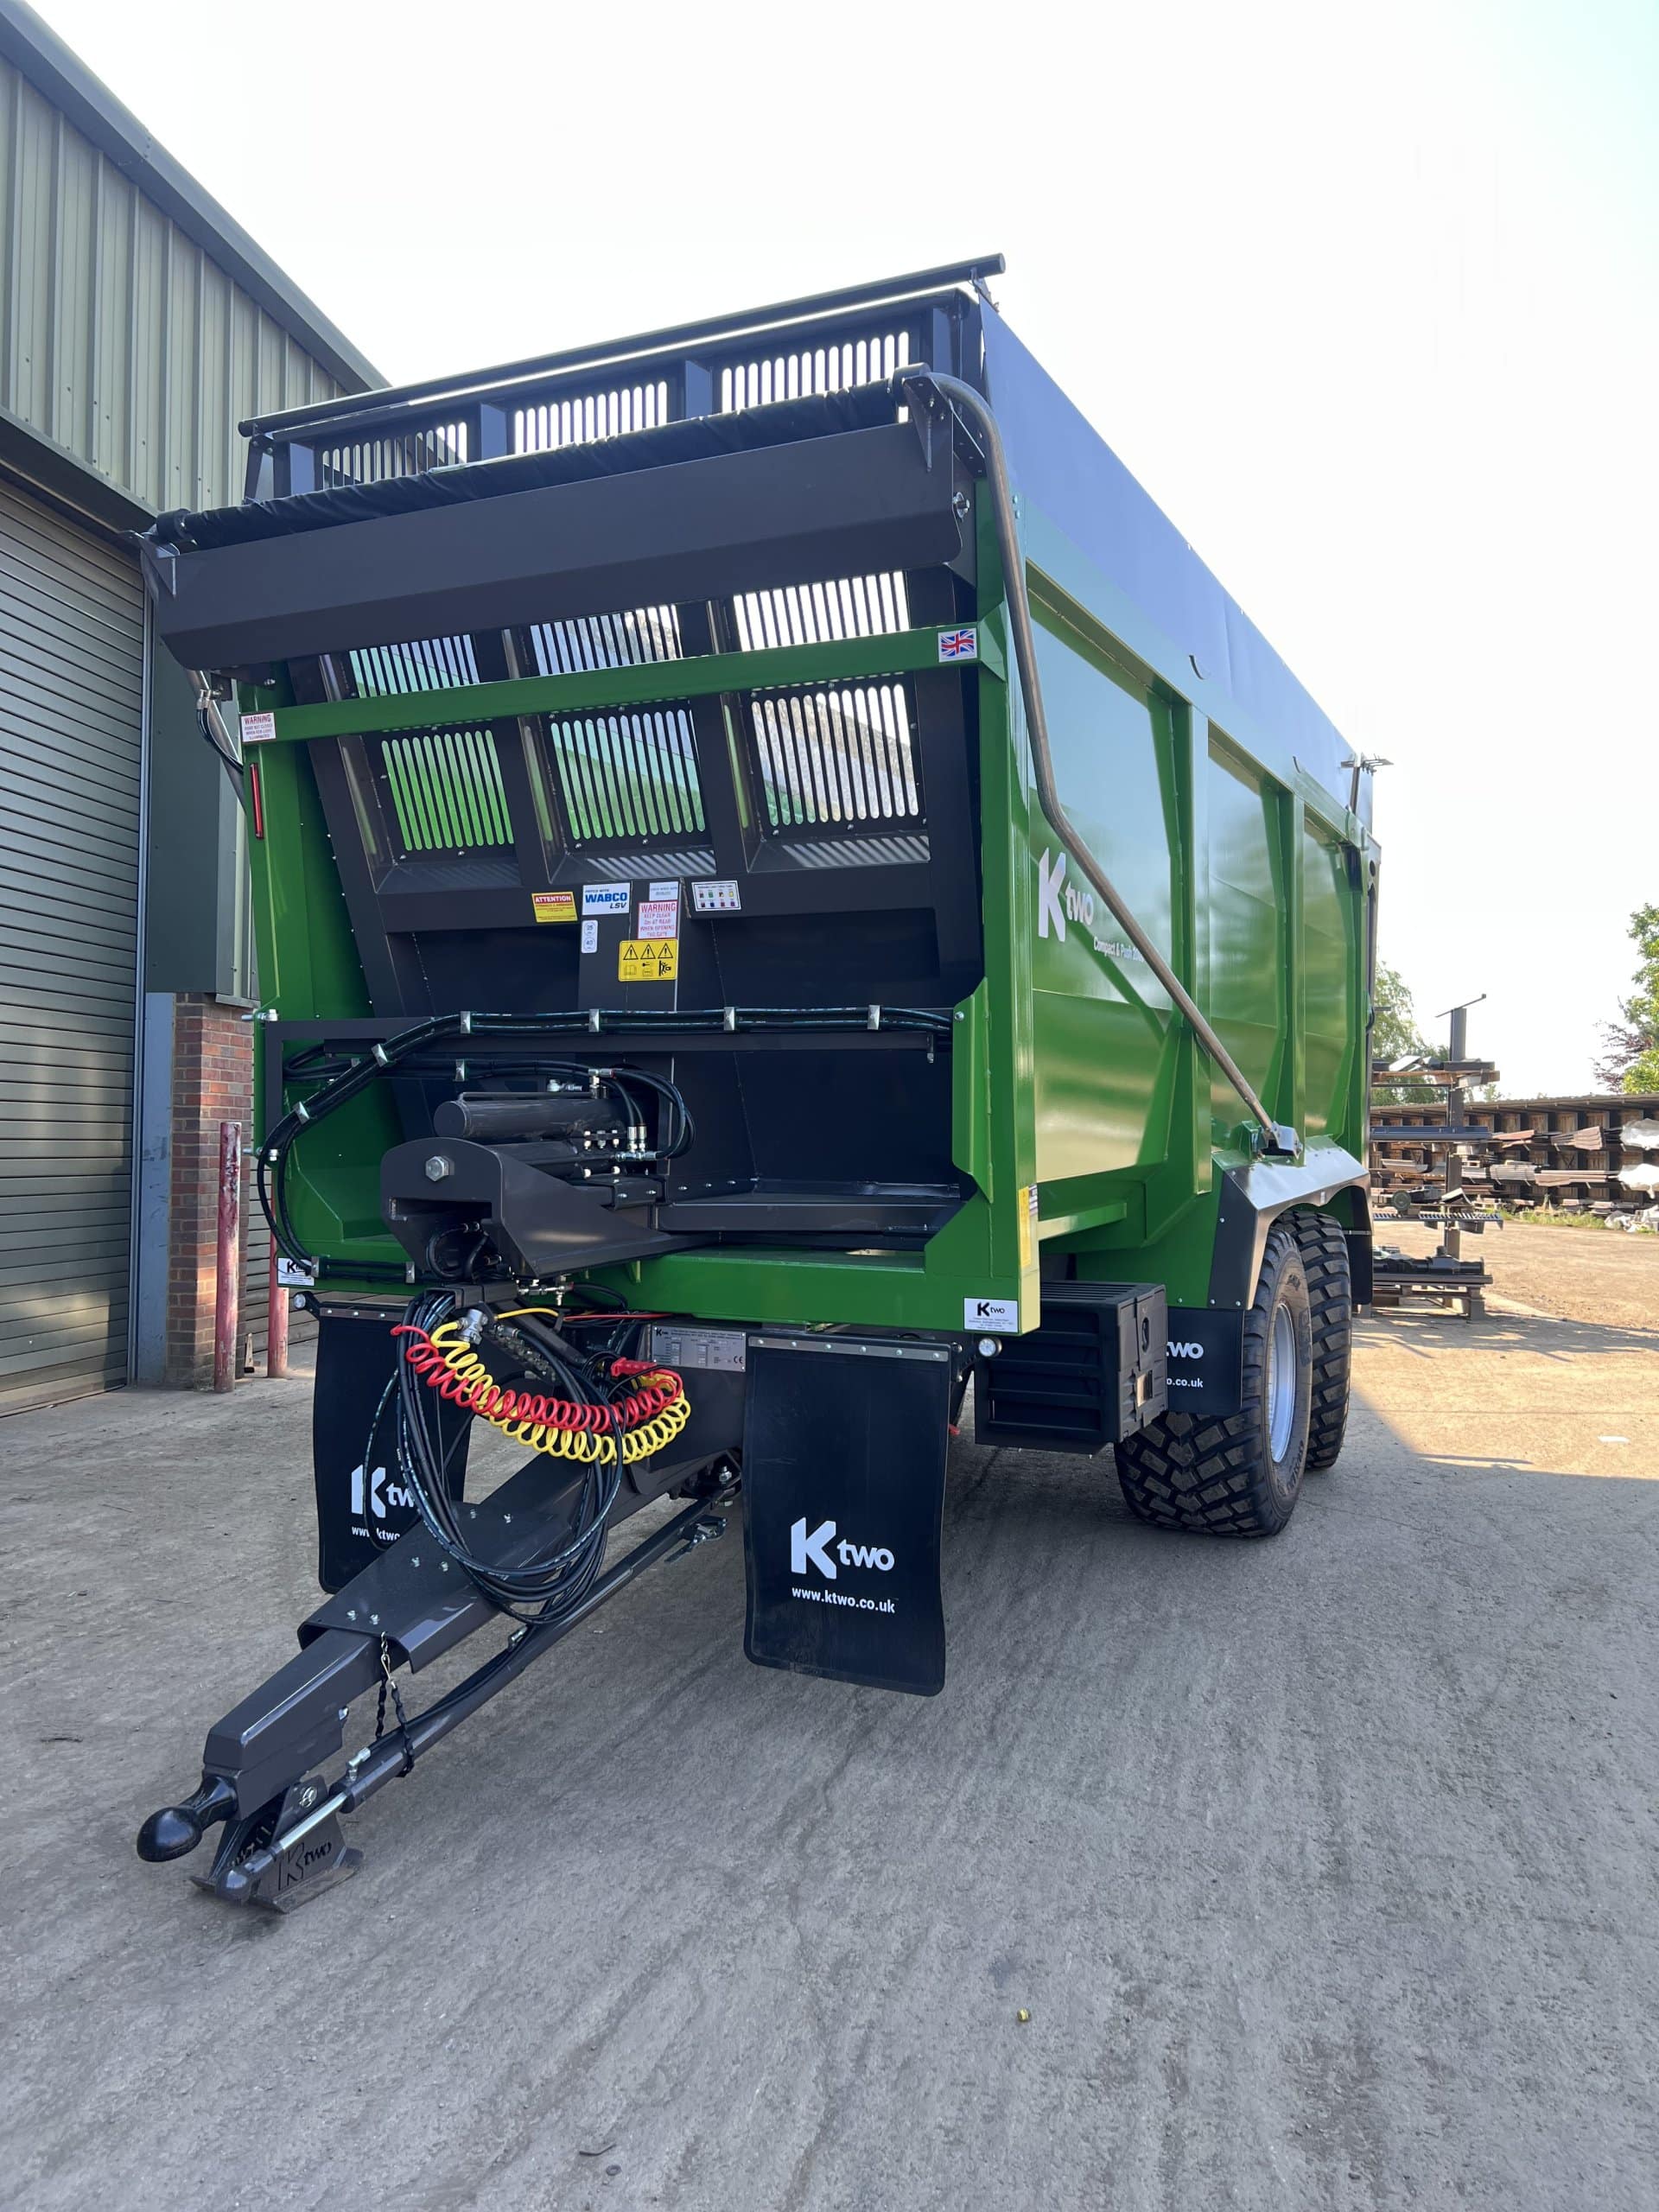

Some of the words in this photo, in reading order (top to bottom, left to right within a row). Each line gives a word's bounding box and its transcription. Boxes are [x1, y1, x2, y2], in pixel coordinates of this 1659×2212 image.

[245, 715, 271, 725] WARNING
[585, 893, 628, 904] WABCO
[641, 903, 677, 913] WARNING
[1166, 1341, 1204, 1359] wo
[791, 1586, 896, 1614] www.ktwo.co.uk
